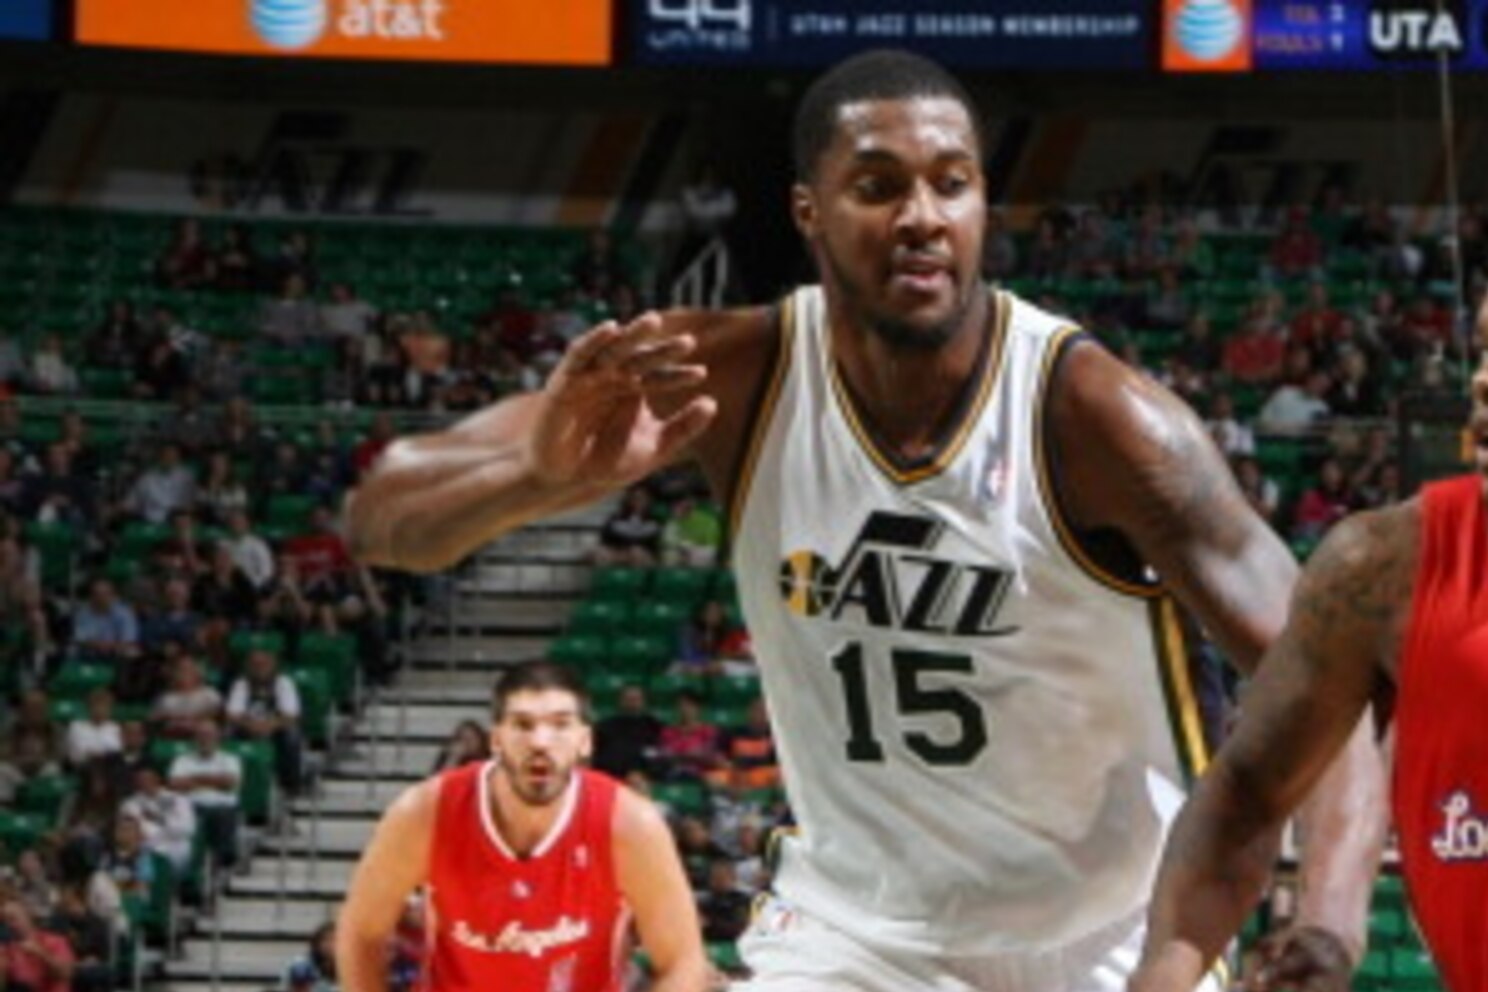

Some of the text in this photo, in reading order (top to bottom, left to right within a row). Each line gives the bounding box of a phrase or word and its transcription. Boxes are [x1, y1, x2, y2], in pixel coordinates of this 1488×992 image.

[338, 0, 445, 40] at&t
[914, 14, 996, 37] SEASON
[1002, 15, 1140, 37] MEMBERSHIP
[1368, 10, 1462, 48] UTA
[779, 509, 1022, 636] JAZZ
[831, 639, 989, 767] 15
